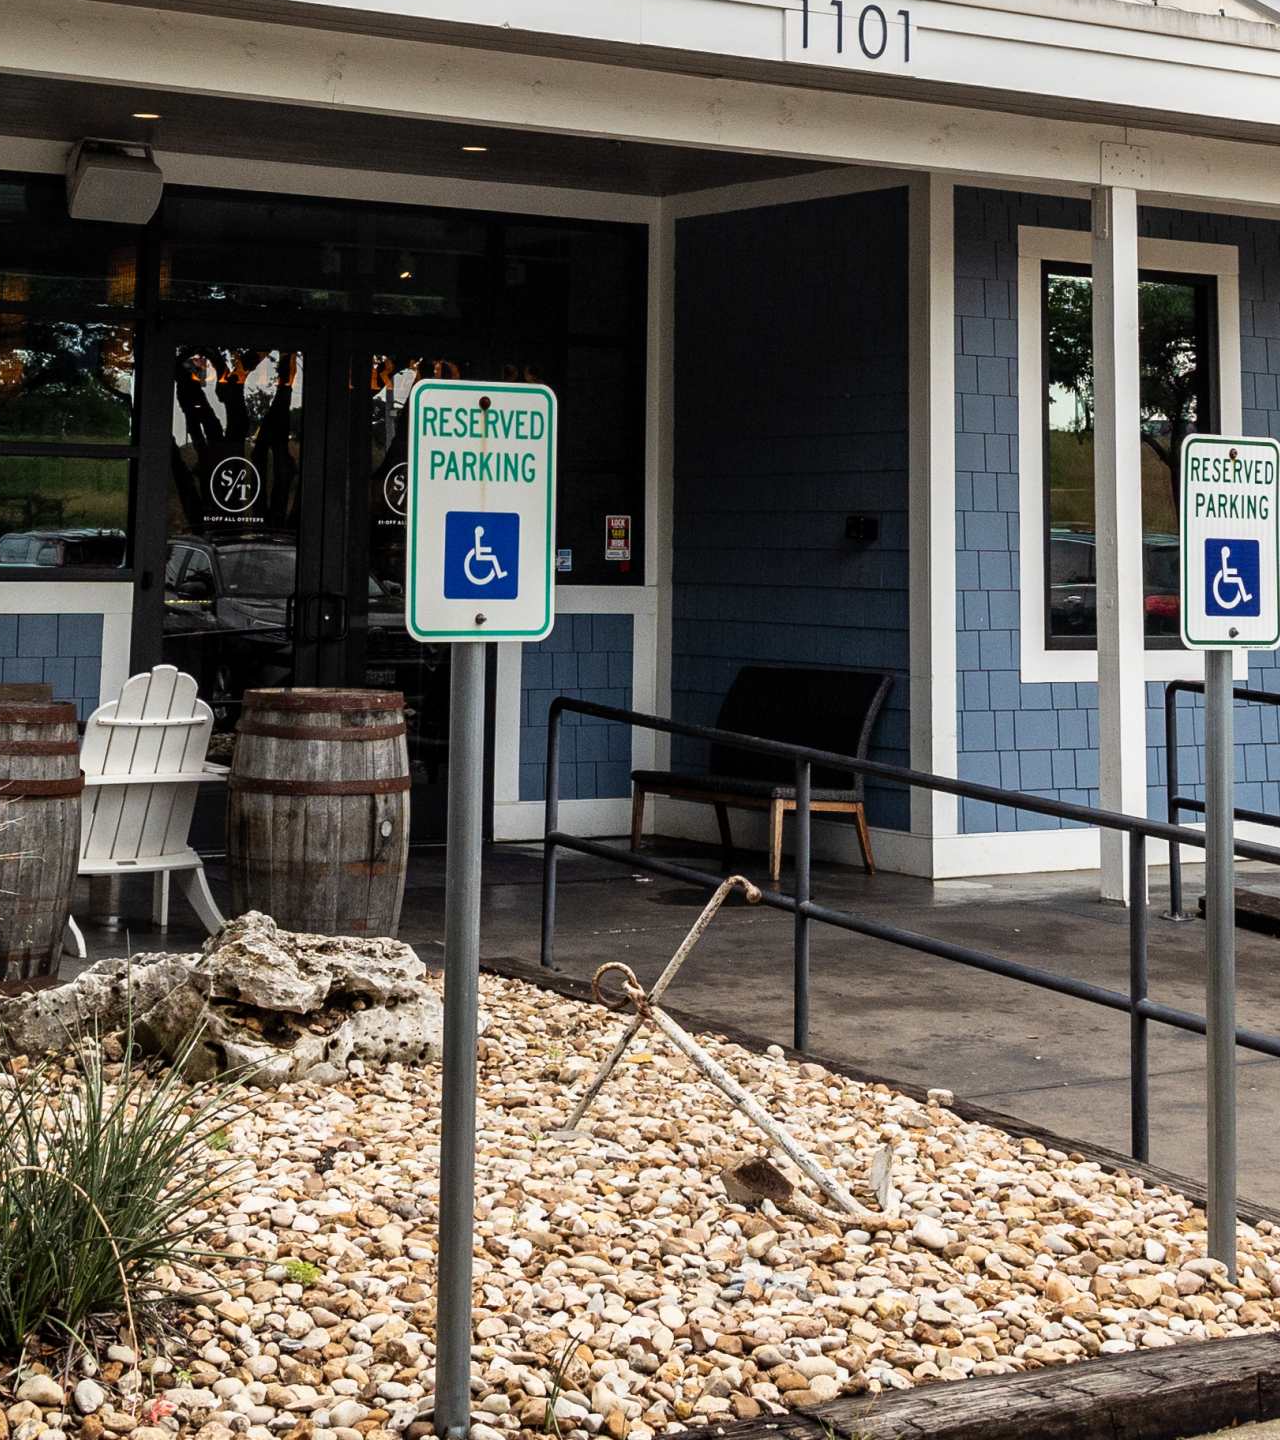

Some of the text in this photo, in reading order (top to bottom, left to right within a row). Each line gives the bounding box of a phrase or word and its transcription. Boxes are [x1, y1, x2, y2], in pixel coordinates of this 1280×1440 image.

[422, 406, 545, 441] RESERVED
[429, 450, 537, 484] PARKING
[1190, 456, 1274, 485] RESERVED
[1195, 492, 1269, 521] PARKING
